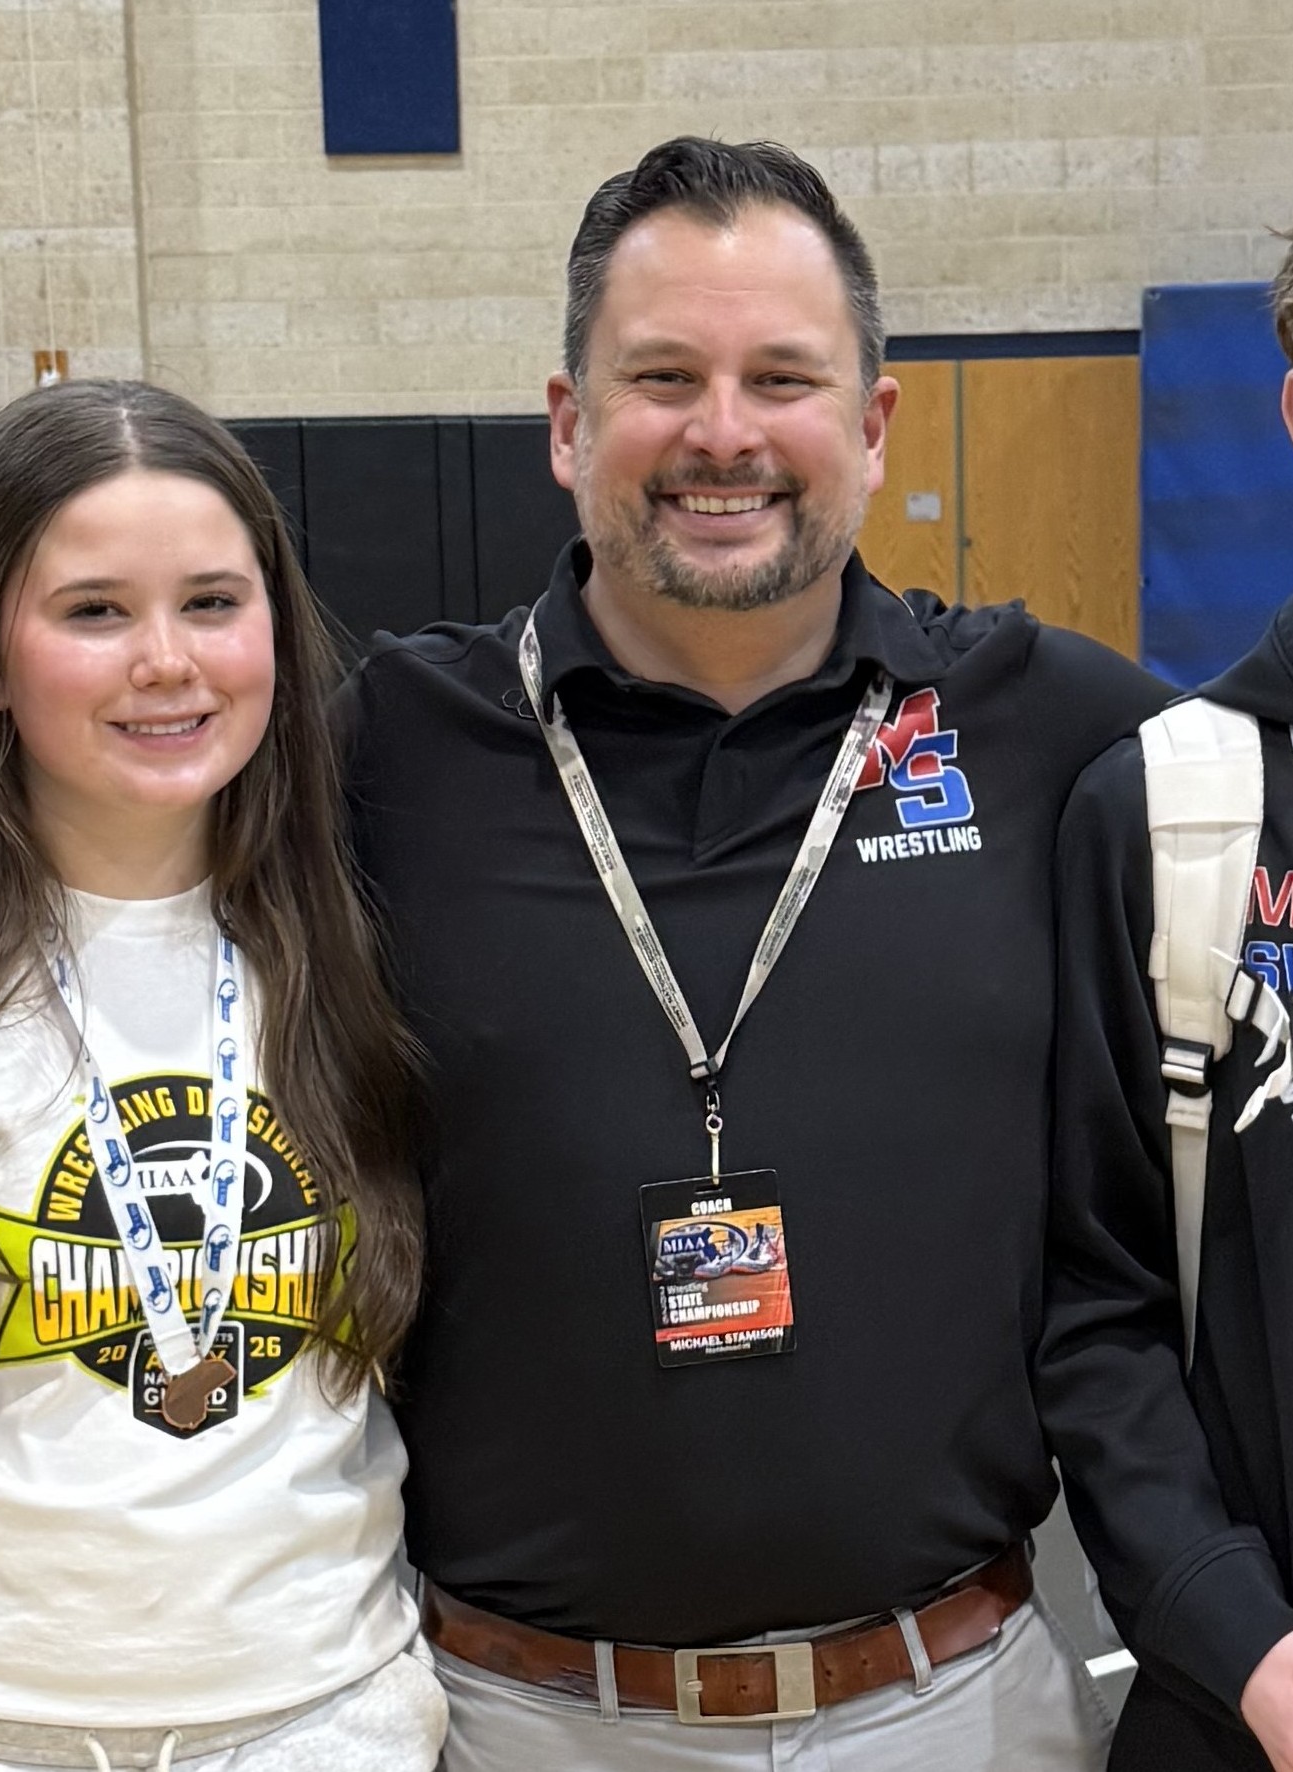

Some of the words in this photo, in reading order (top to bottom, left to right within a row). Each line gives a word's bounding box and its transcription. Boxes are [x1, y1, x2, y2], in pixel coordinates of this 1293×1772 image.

[856, 826, 982, 863] WRESTLING
[691, 1198, 733, 1216] COACH
[668, 1292, 704, 1309] STATE
[670, 1299, 761, 1324] CHAMPIONSHIP
[250, 1336, 281, 1357] 26
[670, 1334, 723, 1352] MICHAEL
[724, 1326, 784, 1345] STAMISON
[96, 1344, 127, 1364] 20
